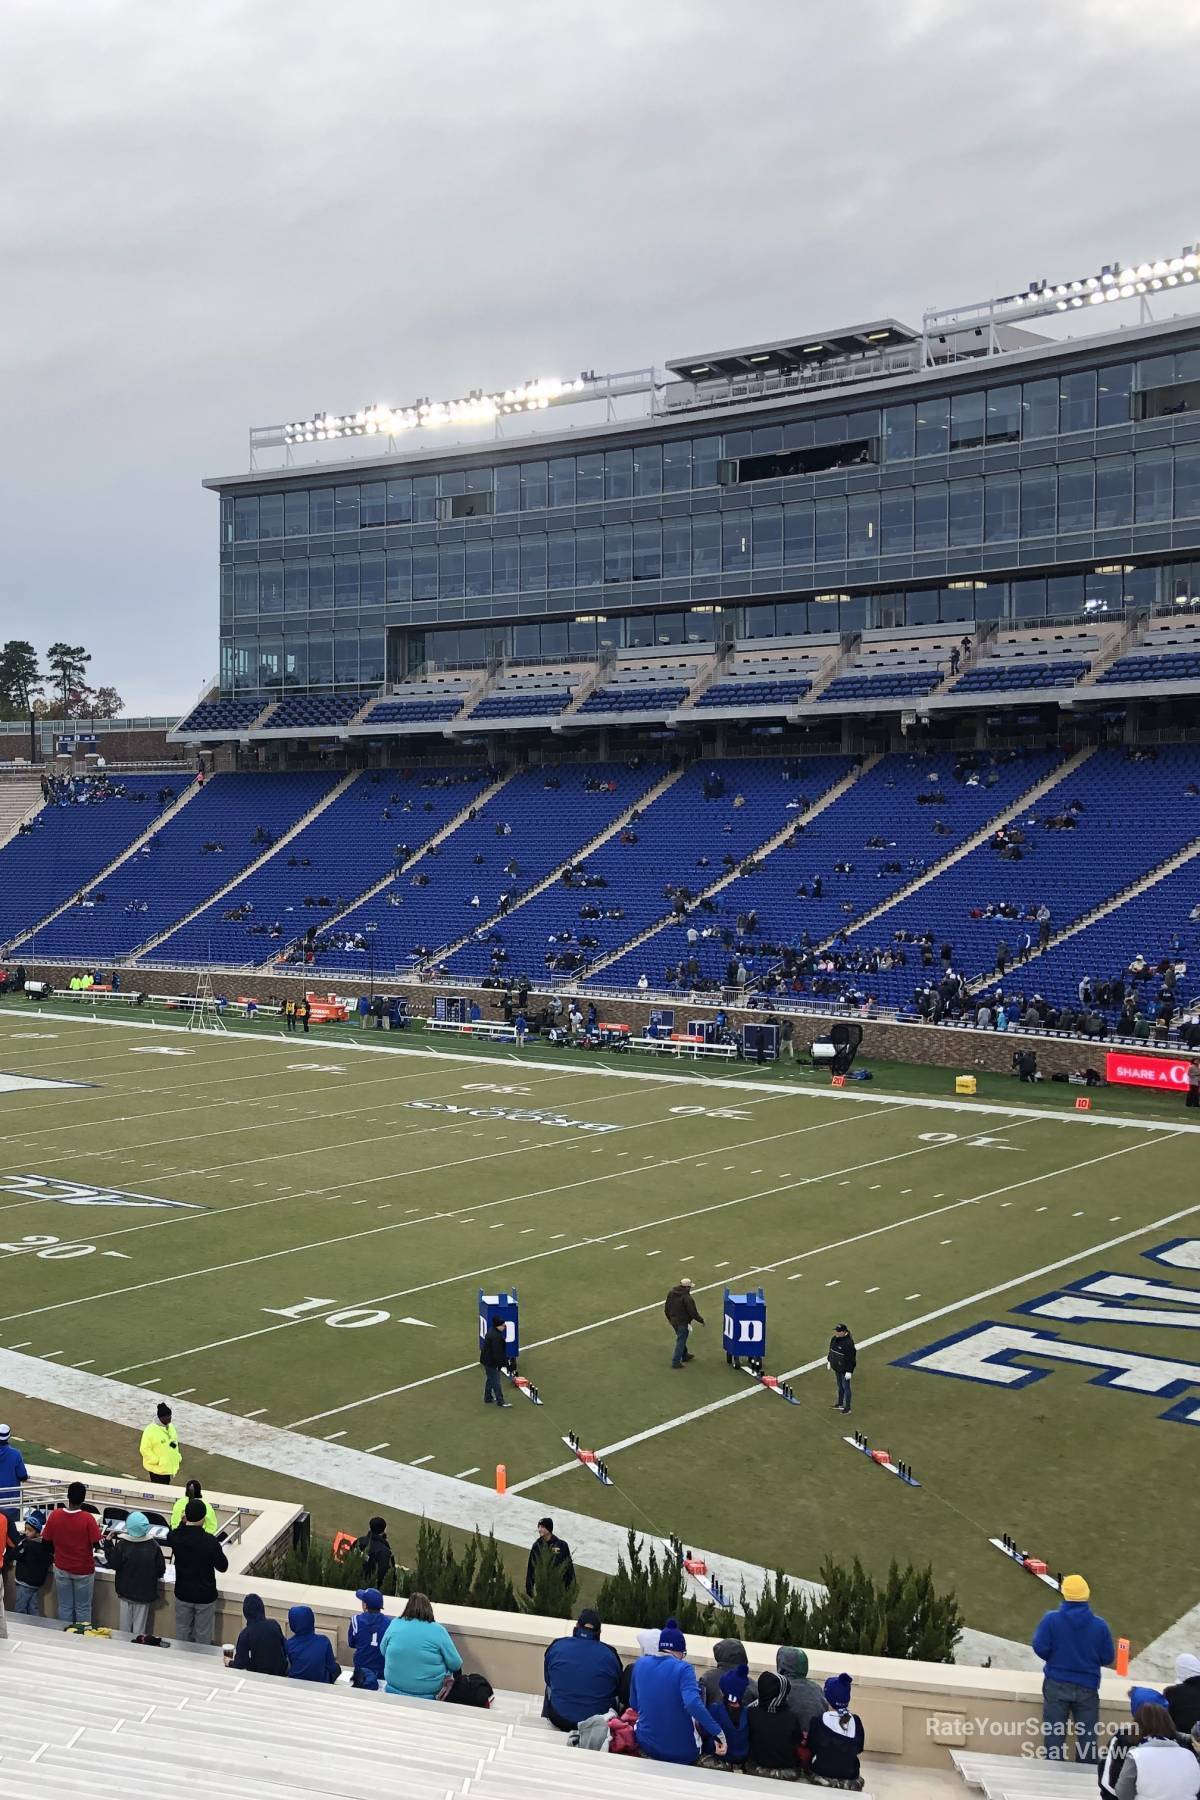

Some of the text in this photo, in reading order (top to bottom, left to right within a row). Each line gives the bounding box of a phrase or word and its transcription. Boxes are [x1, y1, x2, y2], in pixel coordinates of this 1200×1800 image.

[1116, 1066, 1155, 1080] SHARE
[1159, 1072, 1168, 1082] A
[402, 1102, 625, 1132] BROOKS
[667, 1105, 757, 1121] 20
[917, 1131, 1028, 1152] 10
[260, 1296, 391, 1330] 10
[738, 1320, 763, 1342] D
[370, 1632, 379, 1647] 1
